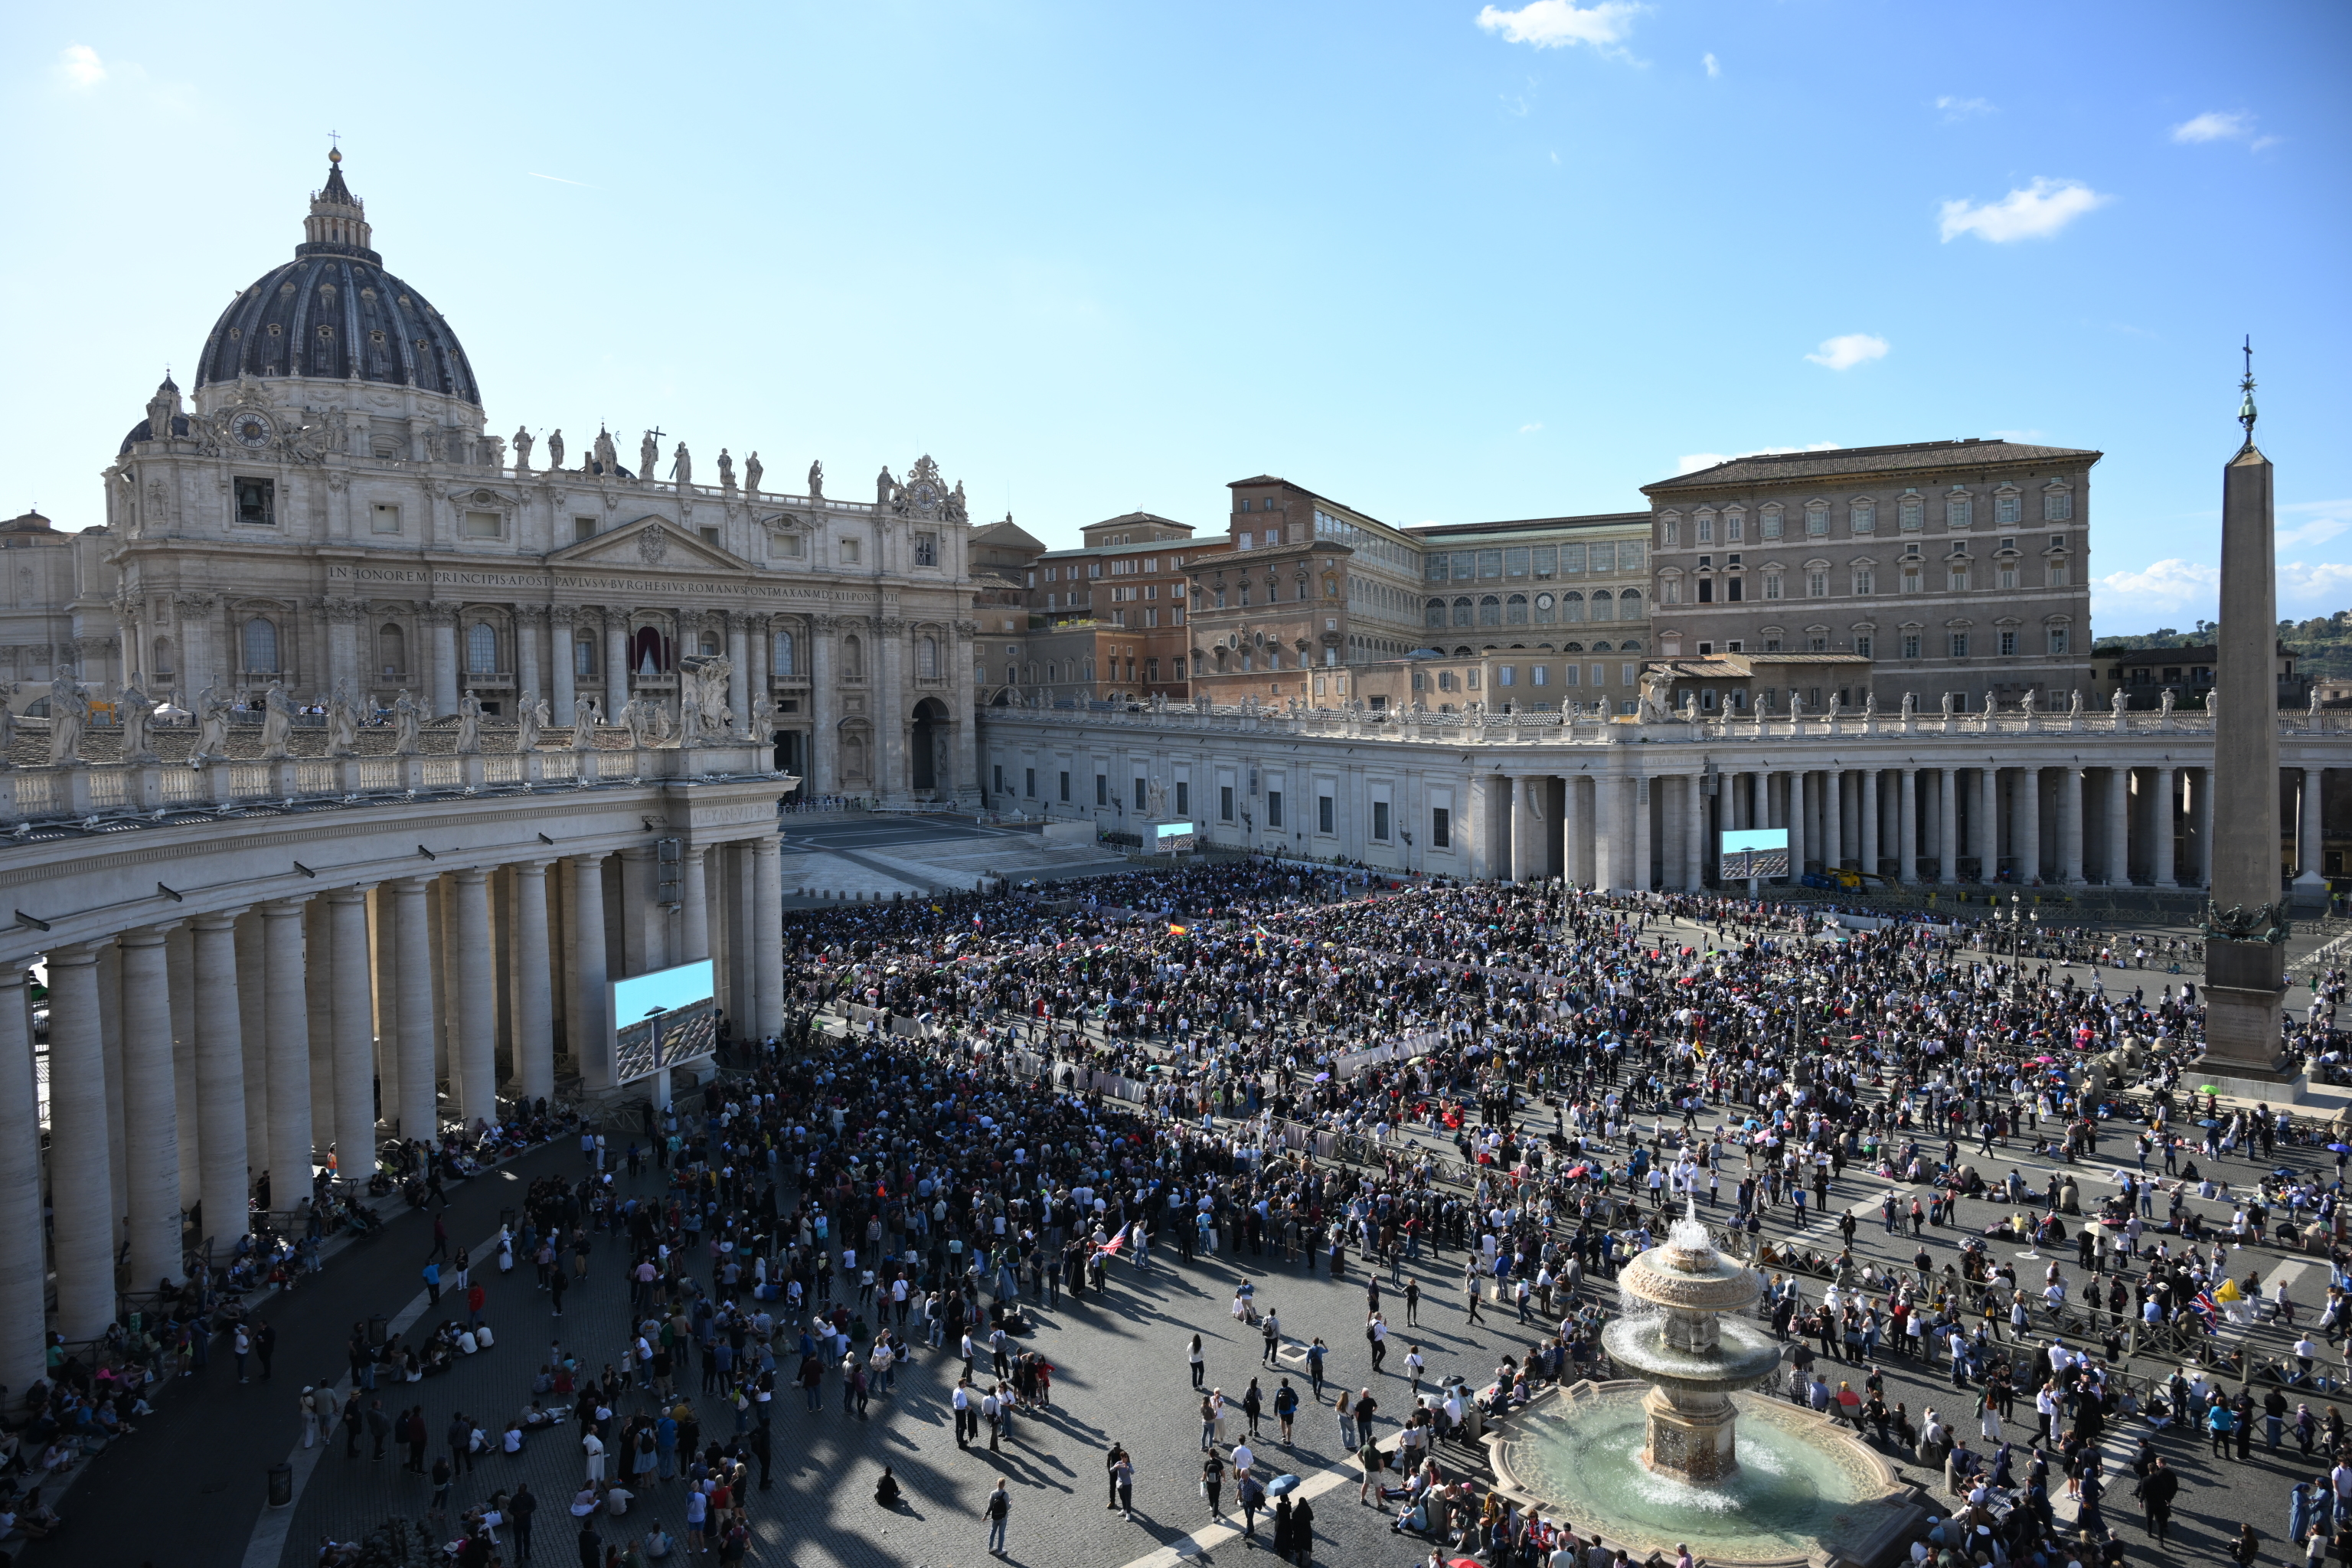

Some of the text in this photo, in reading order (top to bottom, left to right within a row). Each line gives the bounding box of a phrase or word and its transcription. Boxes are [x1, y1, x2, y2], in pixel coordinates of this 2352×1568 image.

[329, 567, 898, 602] IN HONOREM PRINCIPIS APOST PAVLVS V BVRGHESIVS ROMANVS PONT MAX AN MDCXII PONT VII
[692, 804, 775, 824] ALEXAN VII P M
